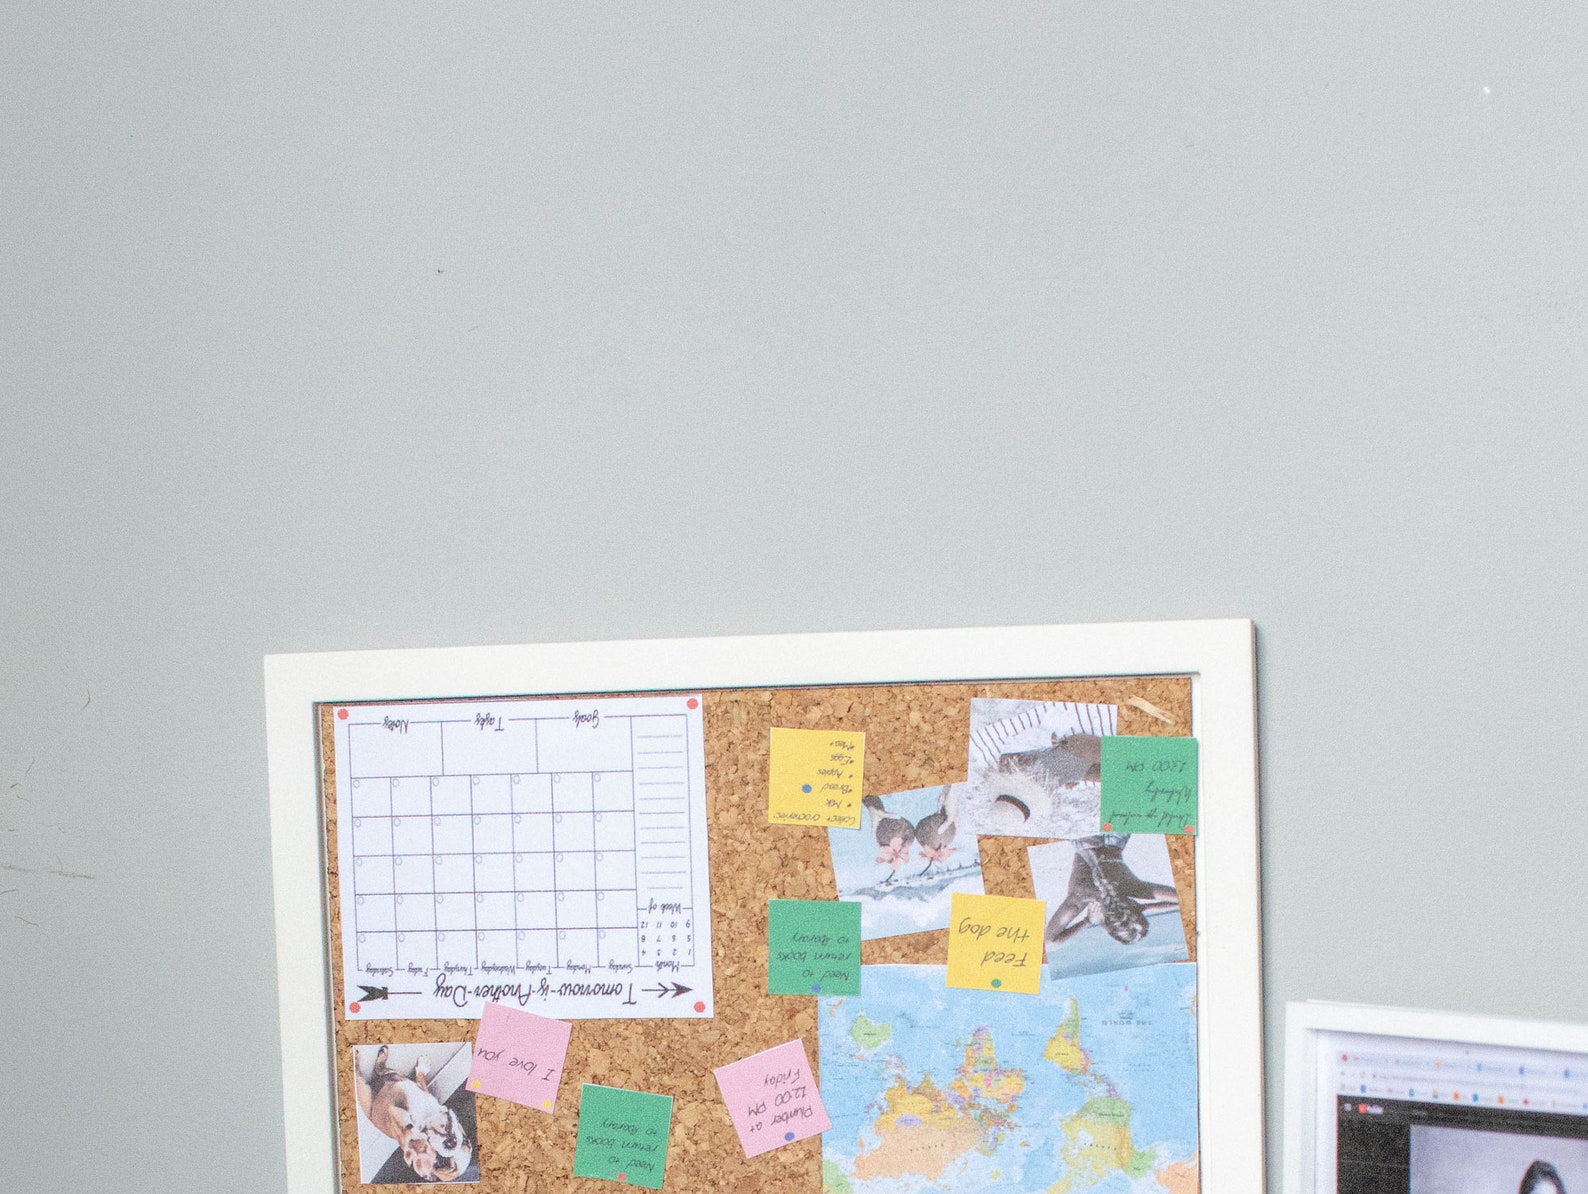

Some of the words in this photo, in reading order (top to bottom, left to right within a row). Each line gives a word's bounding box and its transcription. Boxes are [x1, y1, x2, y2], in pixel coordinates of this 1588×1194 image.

[381, 716, 409, 733] Notes
[473, 713, 504, 732] Tasks
[572, 710, 600, 729] Goals
[661, 903, 681, 915] Week
[958, 917, 992, 941] dog
[997, 926, 1029, 943] the
[566, 959, 591, 974] Monday
[608, 959, 633, 974] Sunday
[980, 950, 1028, 968] Feed
[366, 962, 394, 977] Saturday
[407, 962, 428, 977] Friday
[443, 961, 473, 976] Thursday
[481, 961, 516, 976] Wednesday
[525, 960, 552, 975] Tuesday
[655, 961, 680, 973] Month
[477, 1048, 506, 1061] you
[509, 1057, 537, 1076] love
[541, 1069, 555, 1082] I
[764, 1068, 800, 1088] Friday
[748, 1100, 767, 1117] PM
[749, 1122, 763, 1133] at
